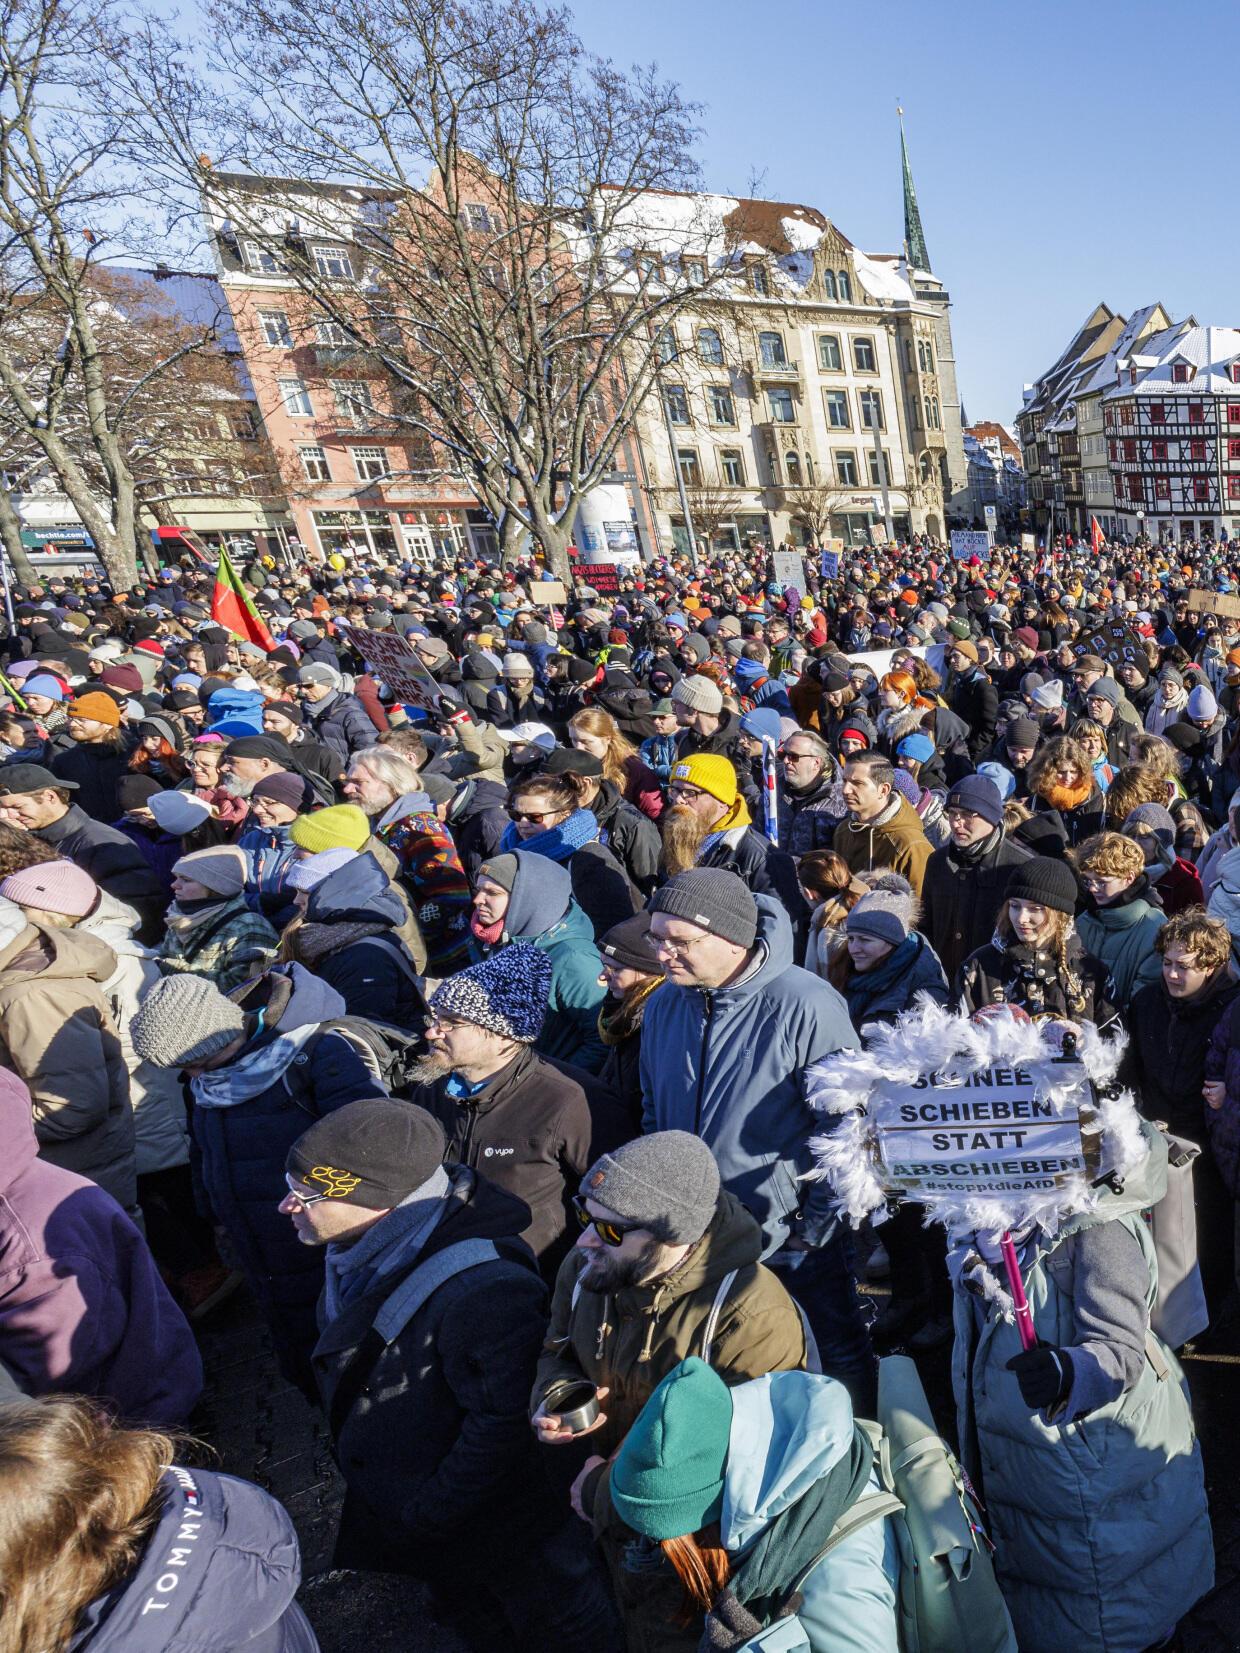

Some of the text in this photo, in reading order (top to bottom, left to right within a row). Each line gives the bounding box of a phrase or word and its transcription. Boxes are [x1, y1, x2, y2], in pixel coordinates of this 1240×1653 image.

[900, 1100, 1052, 1123] SCHIEBEN
[931, 1130, 1028, 1151] STATT
[494, 1148, 515, 1157] vype
[892, 1157, 1083, 1177] ABSCHIEBEN
[926, 1178, 1055, 1194] #stopptdieAfD
[141, 1506, 204, 1616] TOMMY
